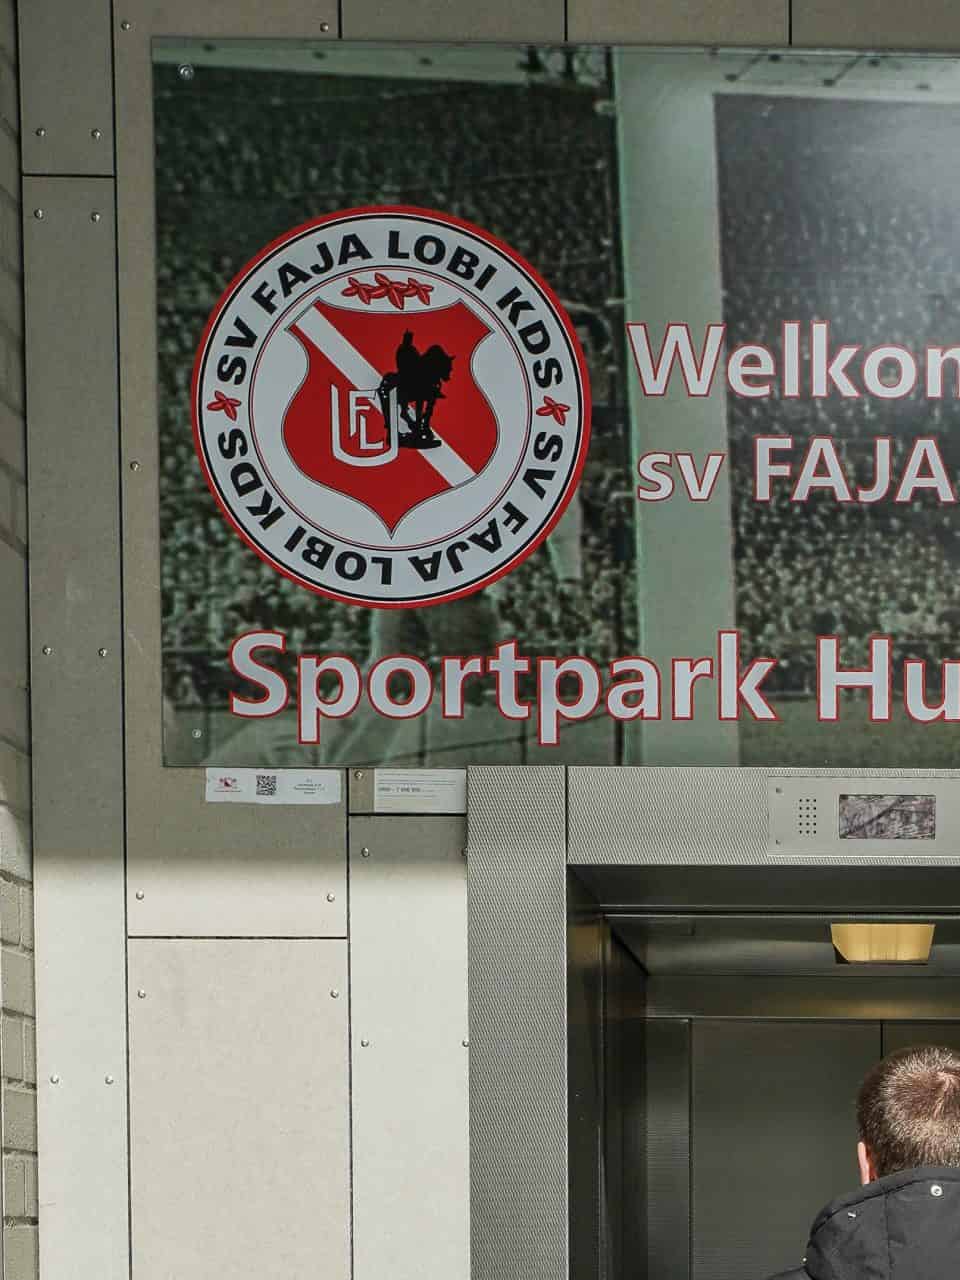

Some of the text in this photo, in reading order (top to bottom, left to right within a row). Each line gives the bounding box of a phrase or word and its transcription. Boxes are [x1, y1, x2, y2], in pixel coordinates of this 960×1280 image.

[216, 230, 563, 389] SV FAJA LOBI KDS
[217, 428, 563, 585] SV FAJA LOBI KDS
[636, 452, 728, 502] sv
[753, 436, 955, 502] FAJA
[228, 629, 780, 745] Sportpark
